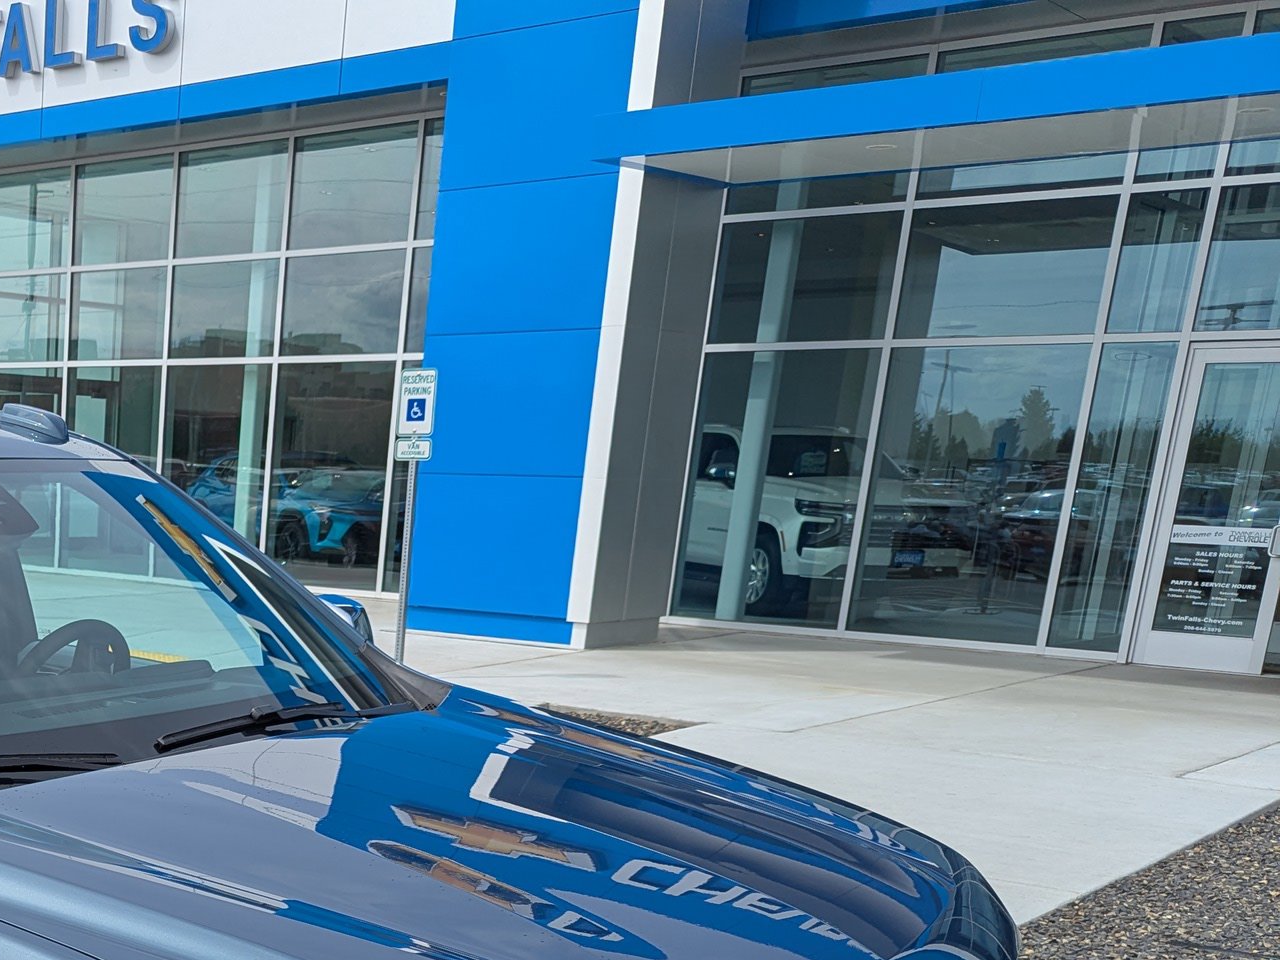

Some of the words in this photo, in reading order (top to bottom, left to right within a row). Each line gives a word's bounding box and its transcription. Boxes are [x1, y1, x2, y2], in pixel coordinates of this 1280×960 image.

[402, 374, 435, 385] RESERVED
[403, 386, 432, 396] PARKING
[1173, 531, 1212, 539] Welcome
